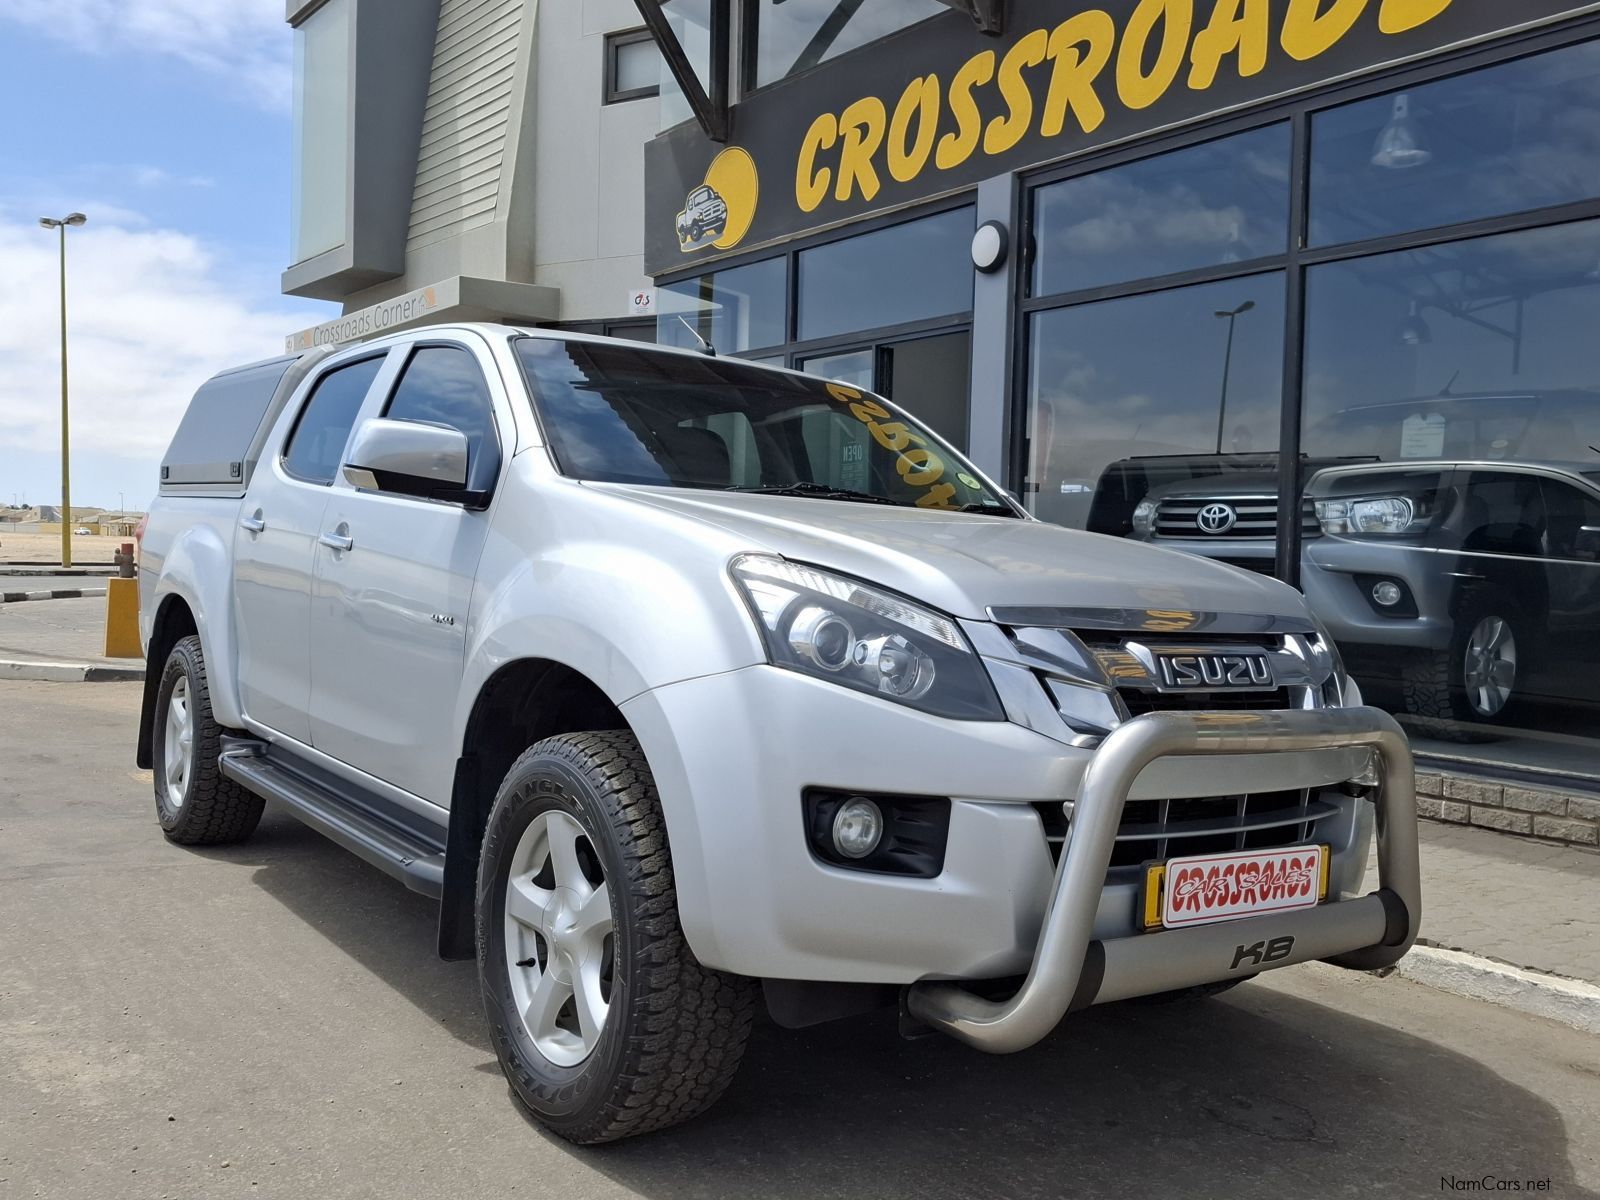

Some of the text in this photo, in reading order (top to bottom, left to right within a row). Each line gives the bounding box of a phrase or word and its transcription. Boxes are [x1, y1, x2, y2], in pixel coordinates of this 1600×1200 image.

[794, 0, 1453, 212] CROSSROA
[313, 297, 417, 347] Crossroads Corner
[1160, 655, 1272, 686] ISUZU
[1172, 855, 1316, 914] CROSSROADS
[1176, 867, 1312, 897] CAR SALES
[1229, 935, 1296, 970] KB
